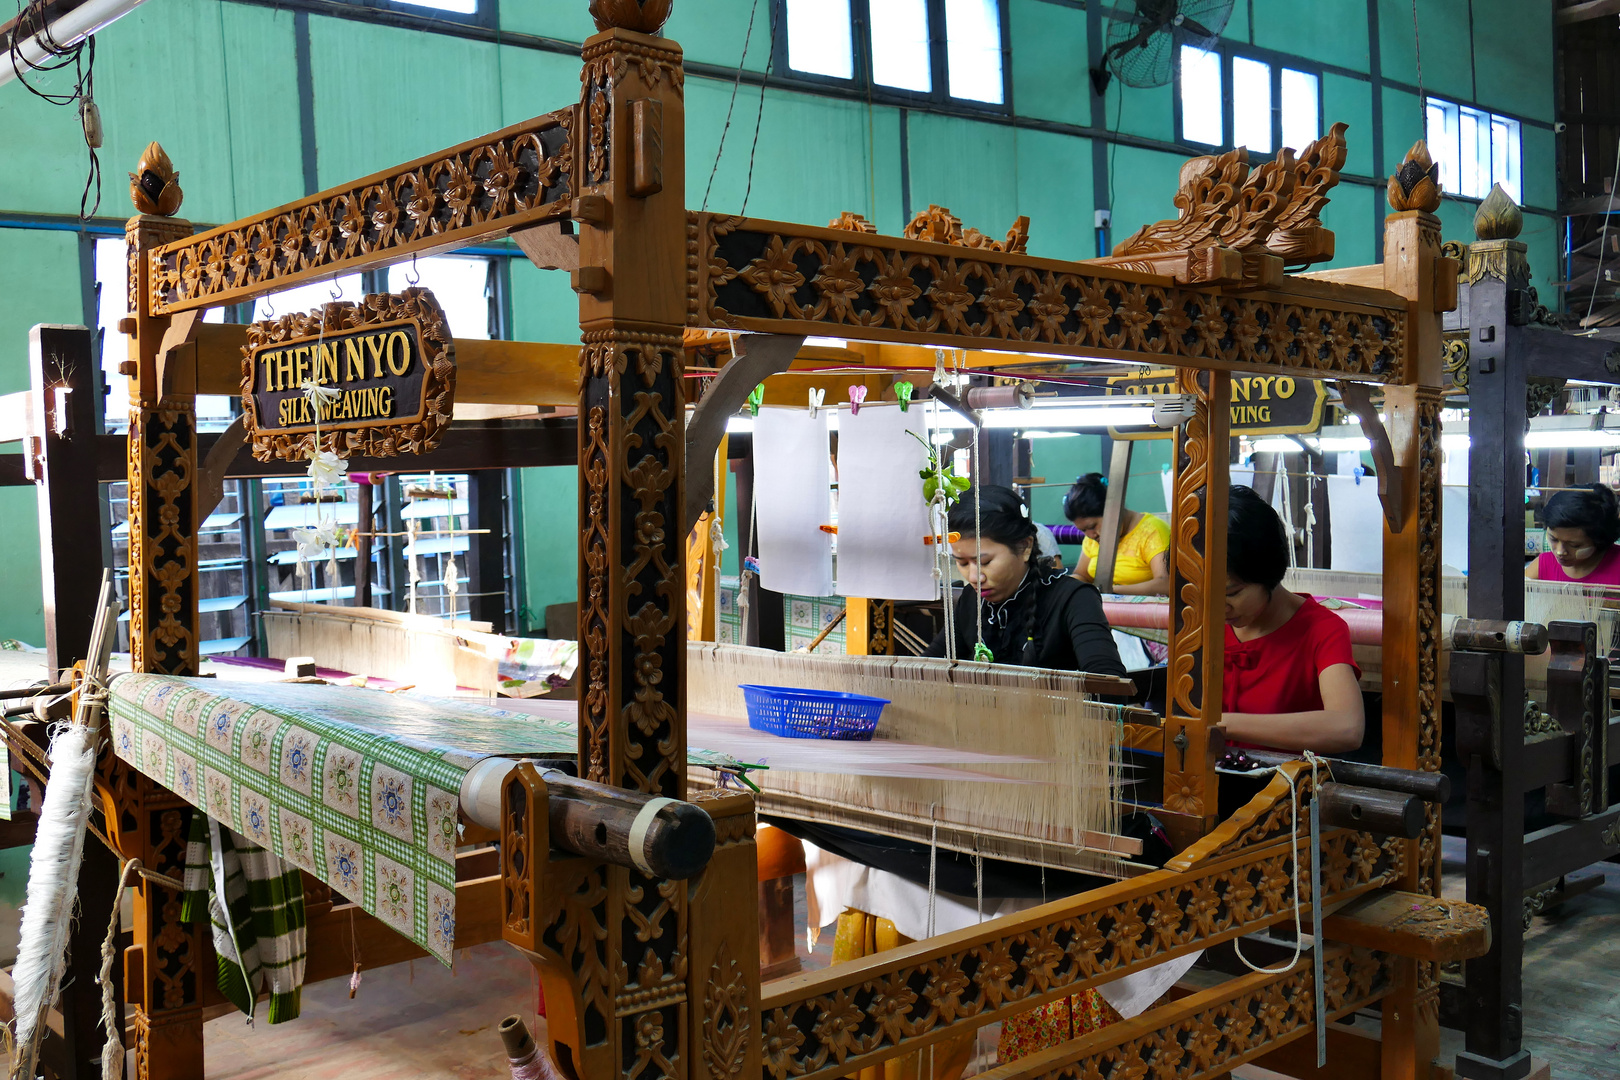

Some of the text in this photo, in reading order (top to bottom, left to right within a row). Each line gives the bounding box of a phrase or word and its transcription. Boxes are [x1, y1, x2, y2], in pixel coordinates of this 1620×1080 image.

[261, 331, 411, 392] THEIN NYO
[1230, 376, 1295, 402] NYO
[279, 396, 311, 427] SILK
[1230, 405, 1271, 424] VING
